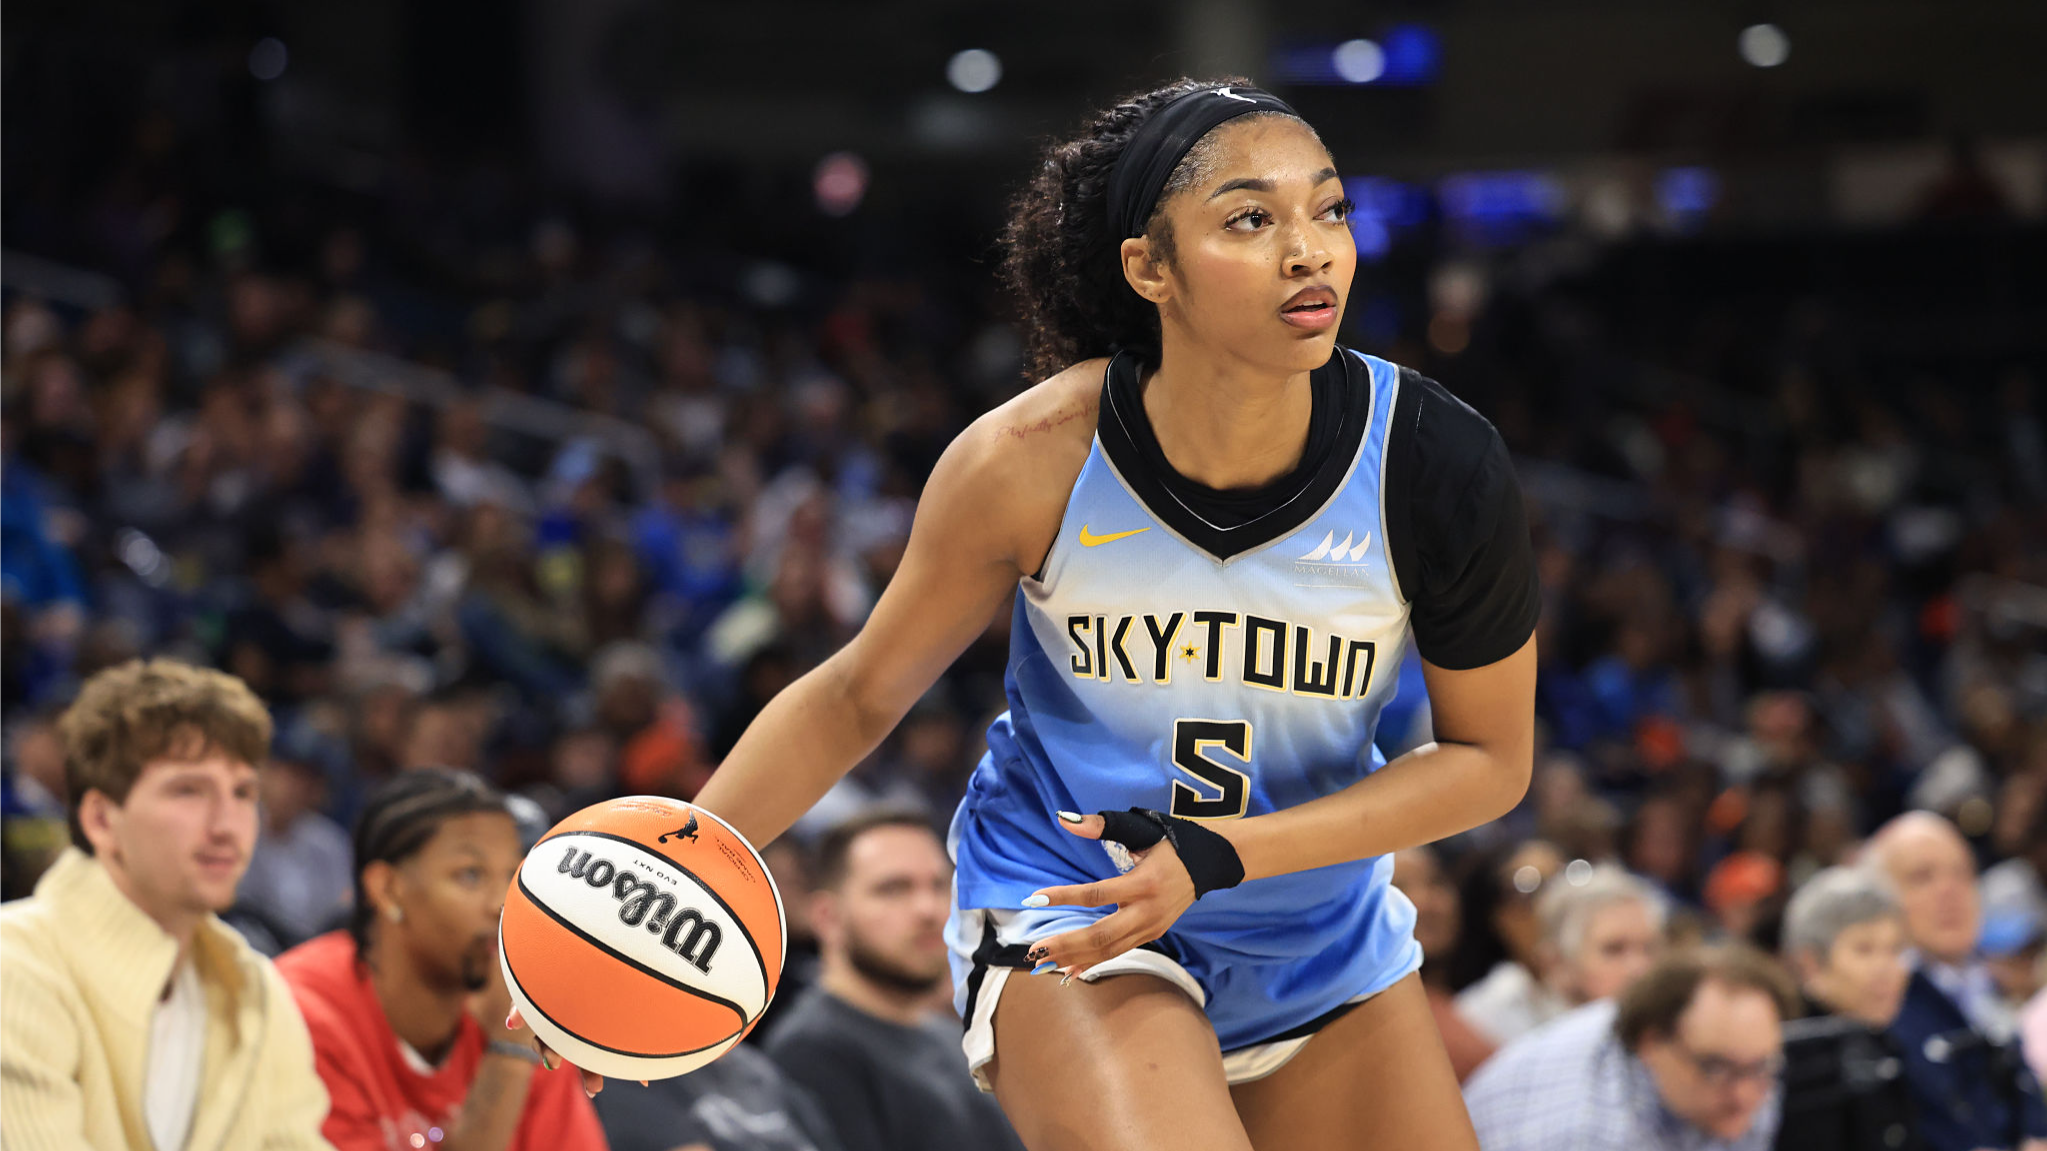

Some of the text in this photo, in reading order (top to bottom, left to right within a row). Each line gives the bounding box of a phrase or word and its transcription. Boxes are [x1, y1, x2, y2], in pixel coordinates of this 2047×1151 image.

[1294, 565, 1369, 577] MAGELLAN
[1170, 717, 1253, 821] 5
[633, 859, 677, 886] EVO NXT
[556, 845, 723, 976] Wilson
